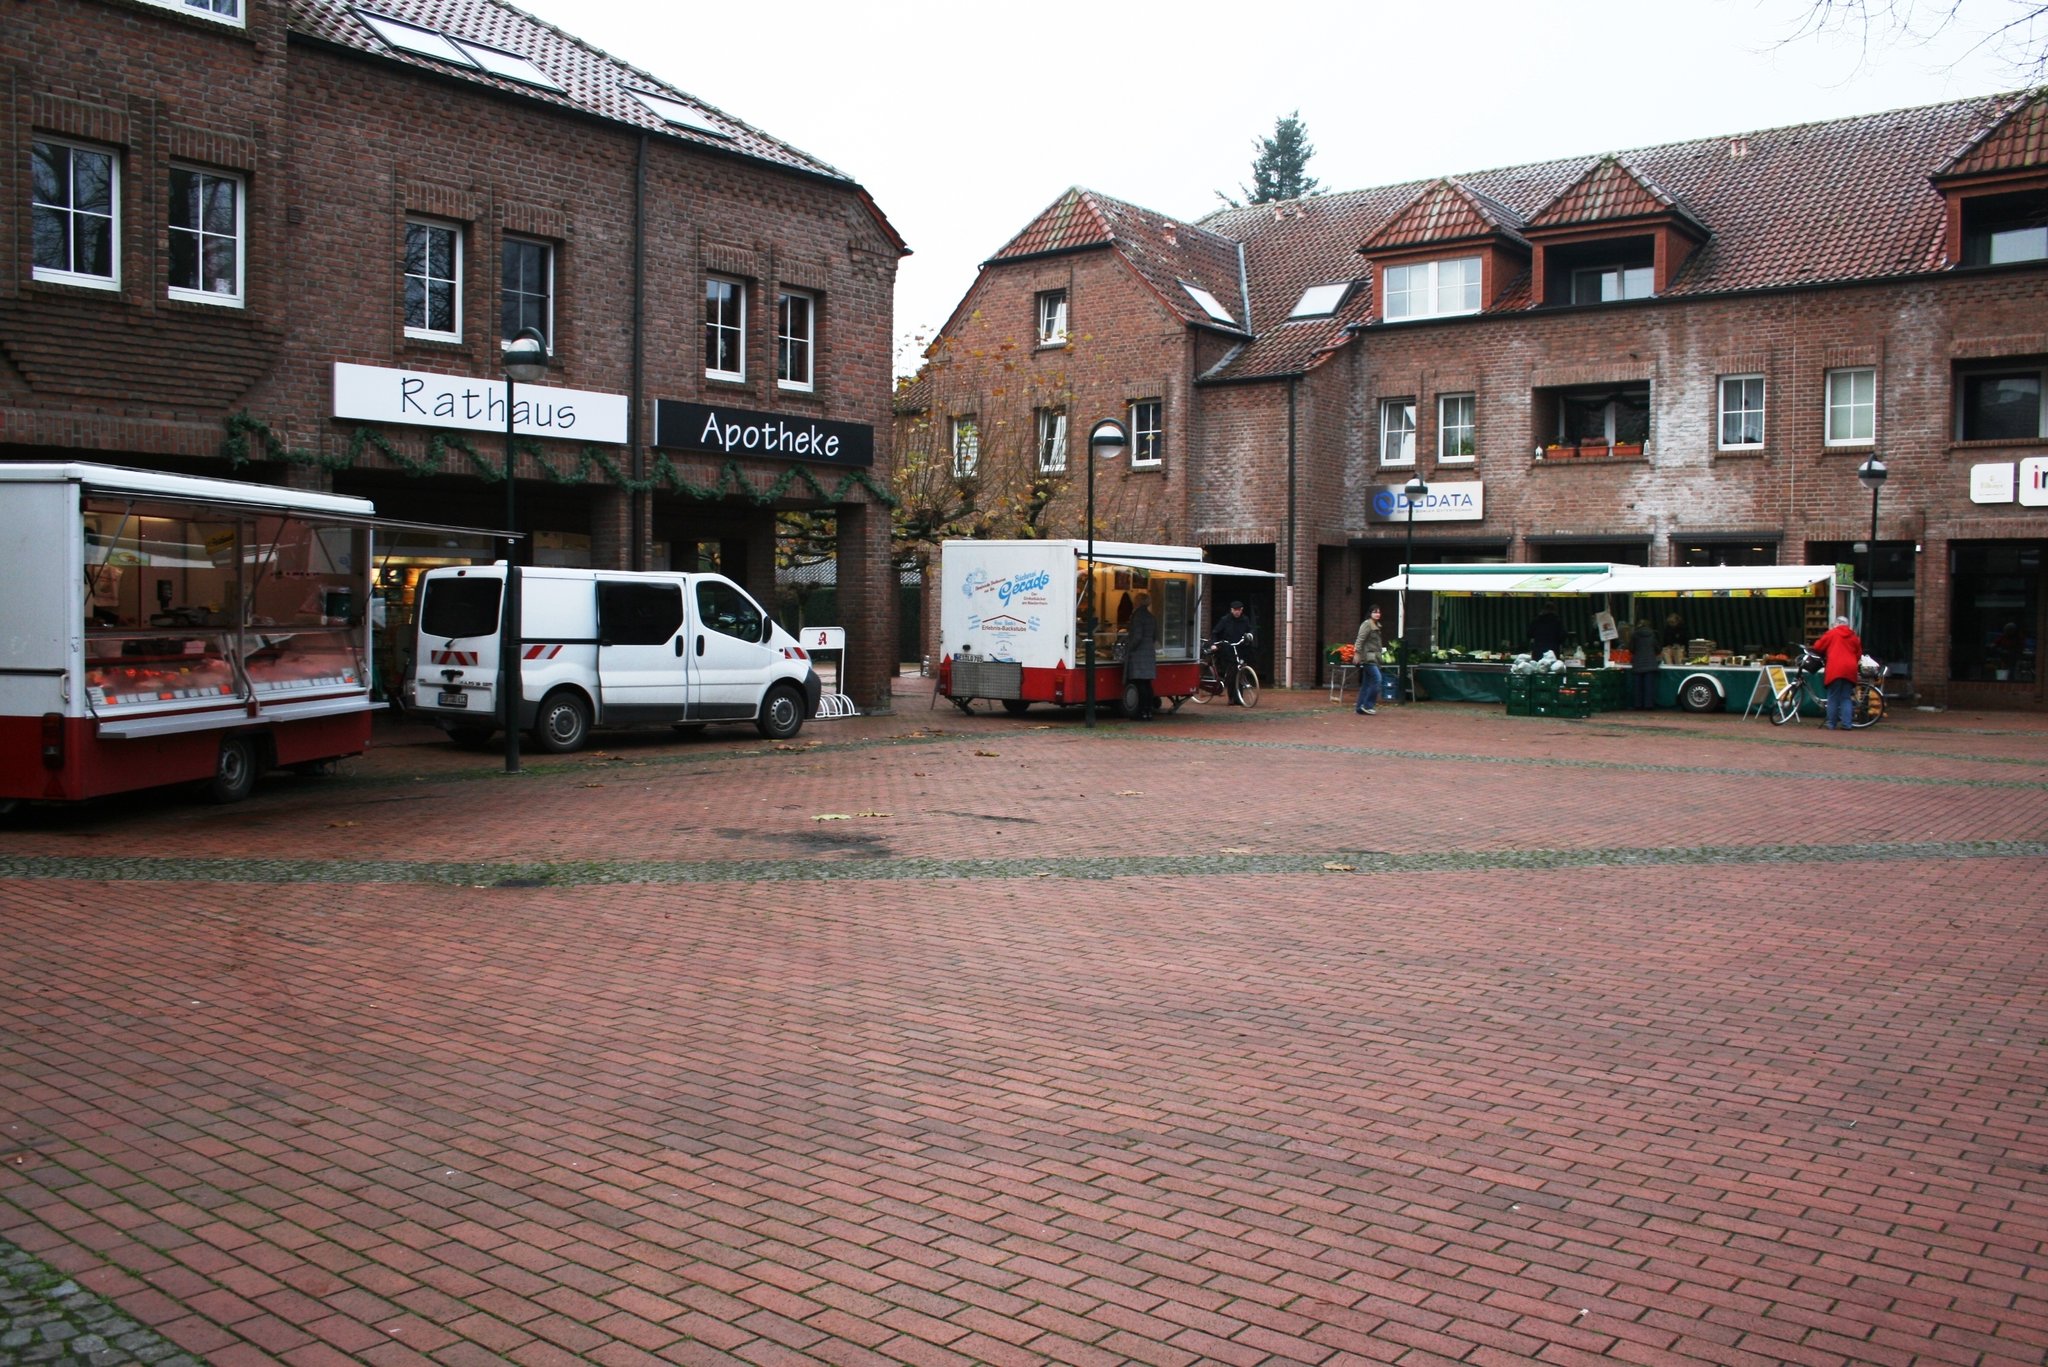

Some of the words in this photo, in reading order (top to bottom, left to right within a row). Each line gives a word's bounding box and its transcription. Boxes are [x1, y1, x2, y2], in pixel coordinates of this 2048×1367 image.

[401, 377, 576, 429] Rathaus
[700, 412, 840, 457] Apotheke
[998, 569, 1050, 607] Gerads
